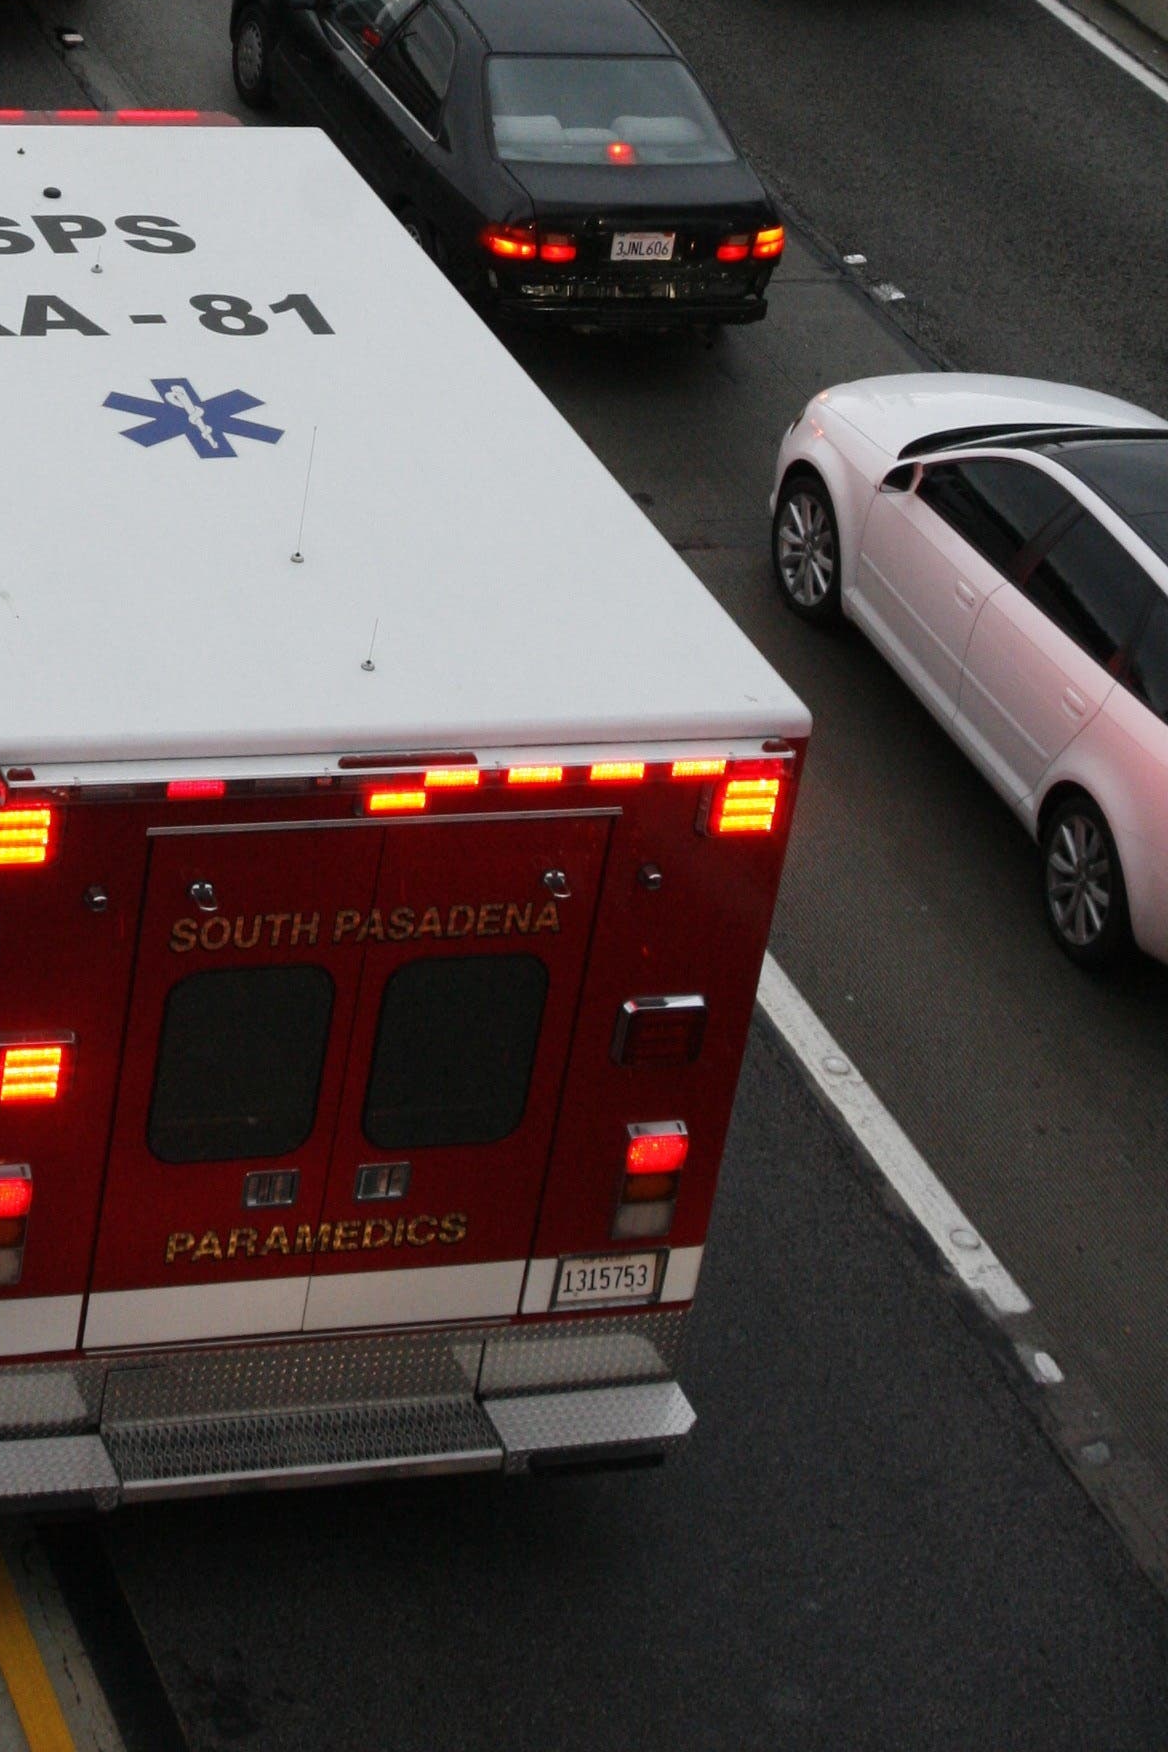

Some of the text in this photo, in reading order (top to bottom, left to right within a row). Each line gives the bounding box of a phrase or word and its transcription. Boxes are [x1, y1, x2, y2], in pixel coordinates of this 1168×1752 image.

[616, 241, 669, 256] 3JNL606
[189, 293, 336, 337] 81
[169, 901, 561, 953] SOUTH PASADENA
[165, 1212, 469, 1263] PARAMEDICS
[563, 1264, 648, 1293] 1315753
